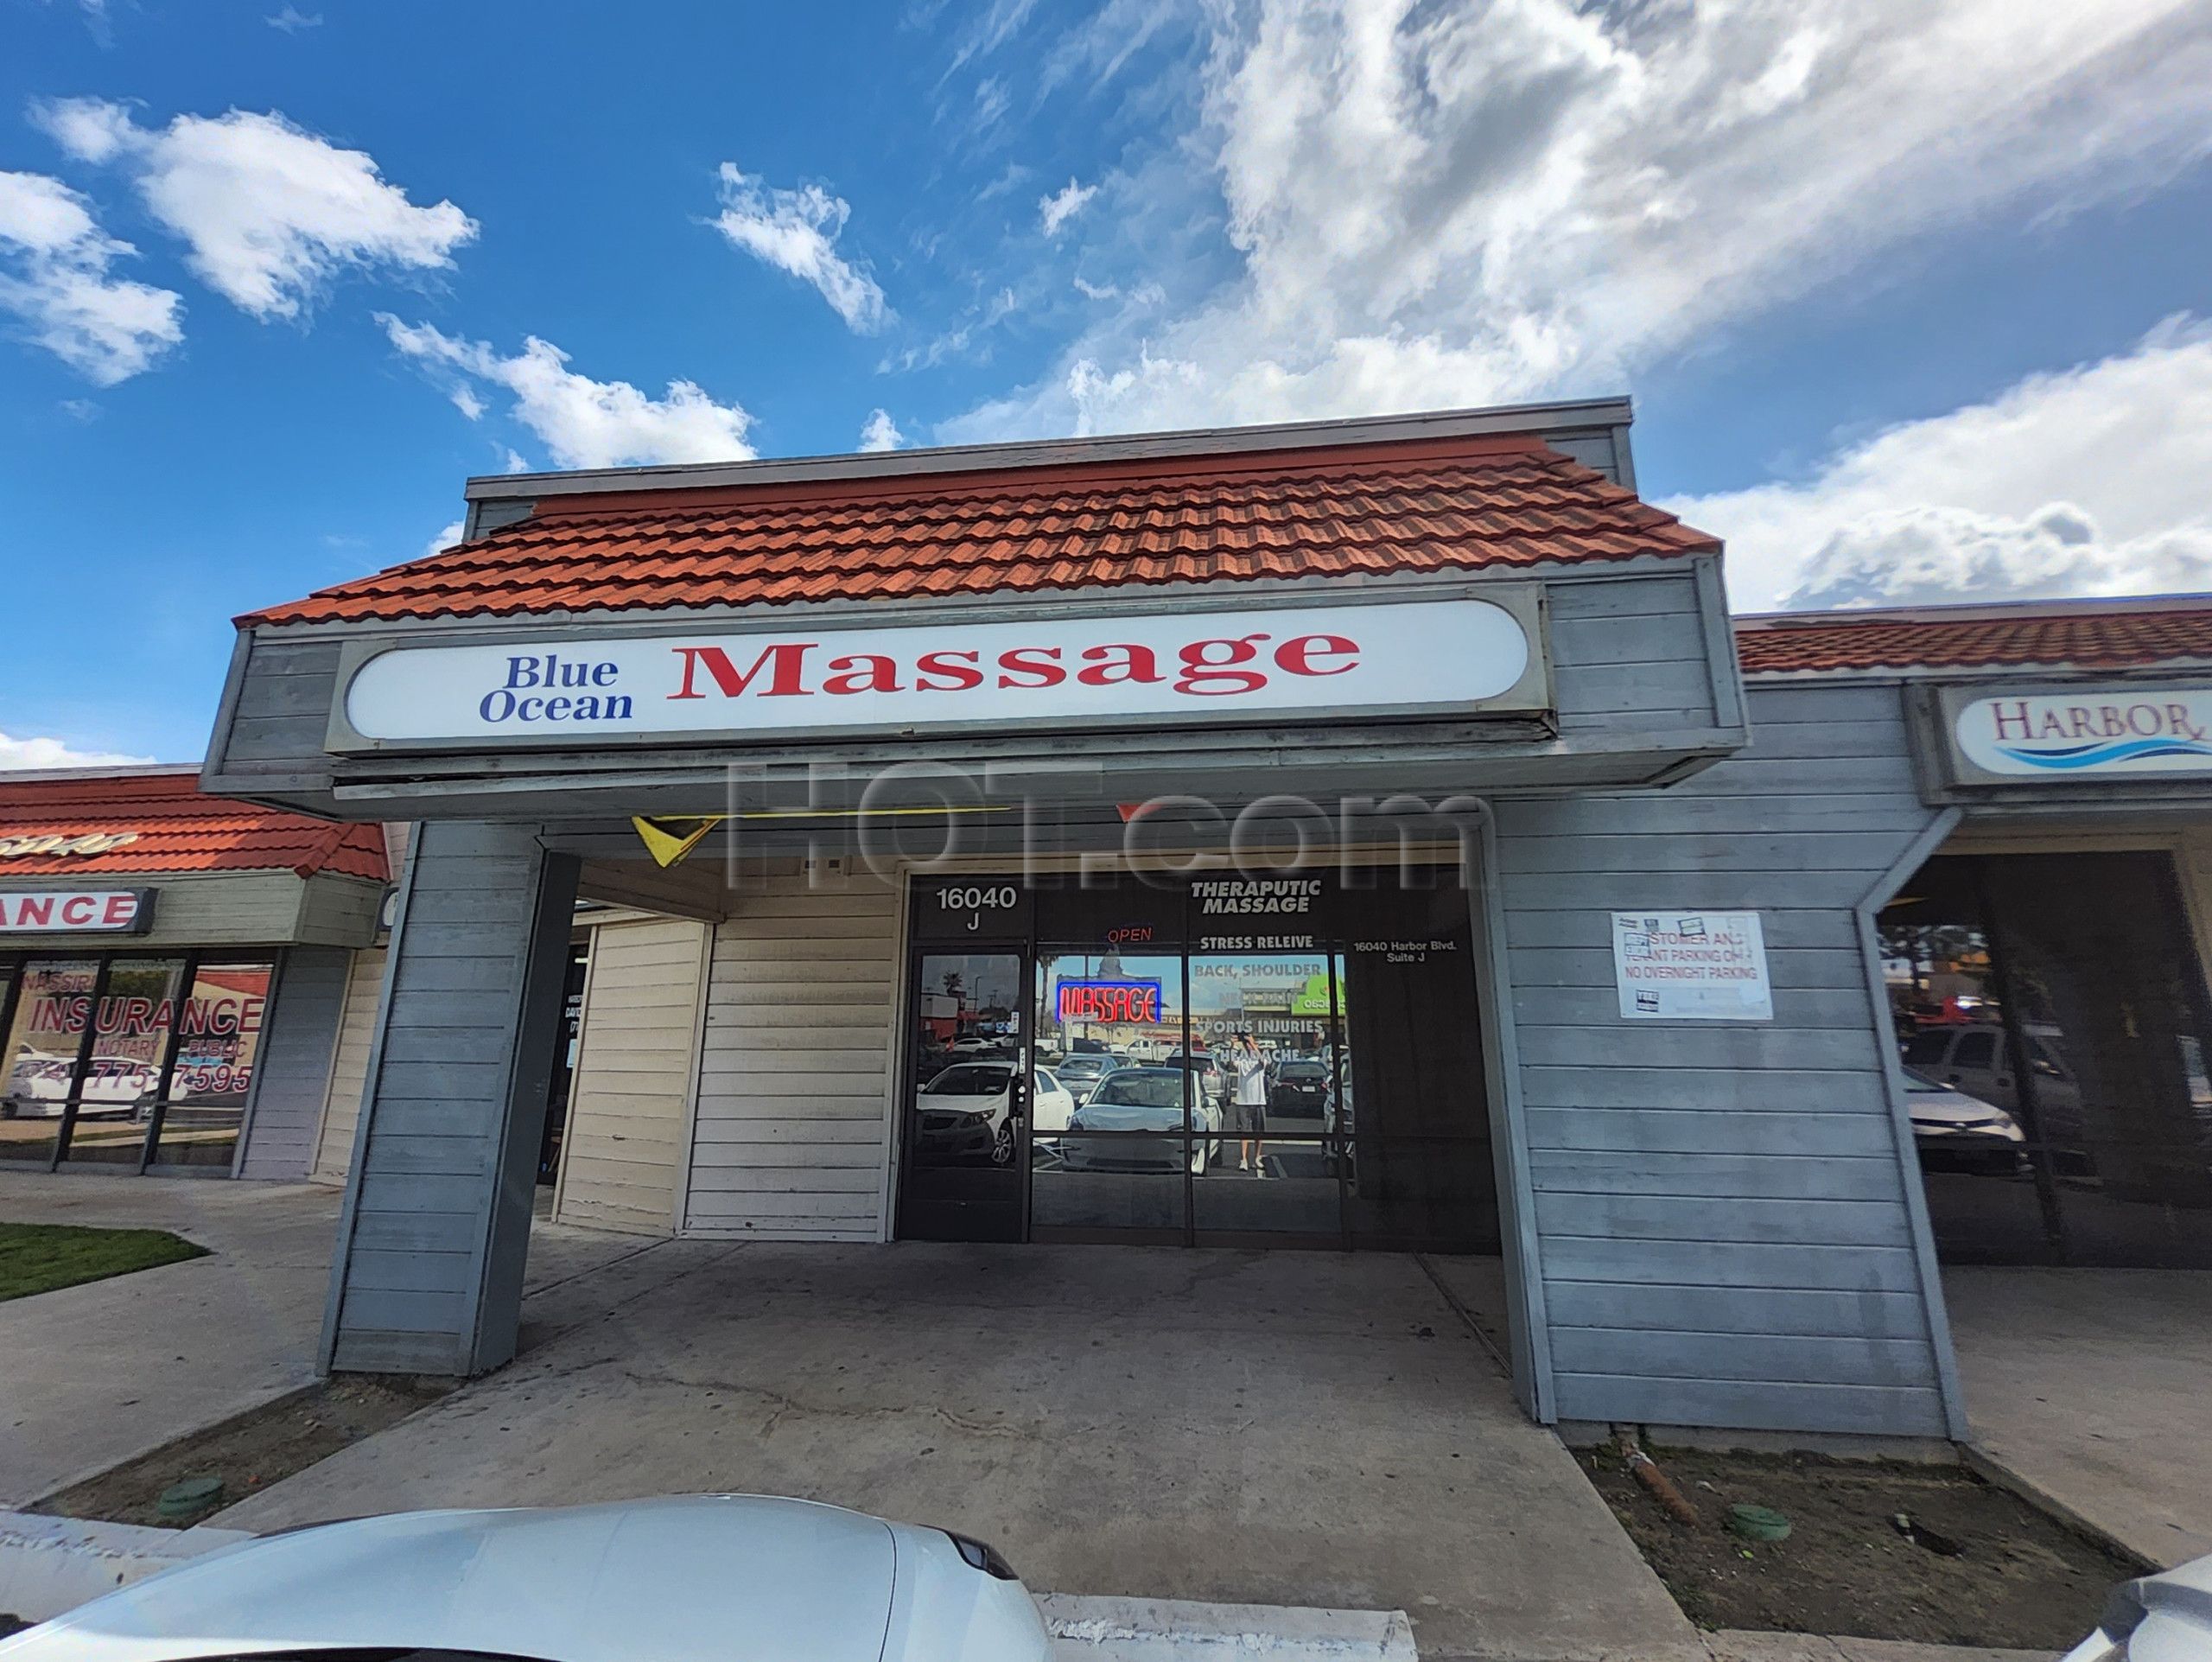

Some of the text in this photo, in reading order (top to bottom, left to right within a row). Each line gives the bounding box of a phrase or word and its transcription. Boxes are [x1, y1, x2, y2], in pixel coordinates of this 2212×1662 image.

[502, 654, 619, 689] Blue
[667, 634, 1361, 699] Massage
[479, 690, 632, 723] Ocean
[936, 887, 1017, 909] 16040
[1191, 880, 1321, 898] THERAPUTIC
[0, 895, 138, 927] NCE
[1202, 896, 1310, 914] MASSAGE
[967, 913, 980, 931] J
[1107, 927, 1153, 944] OPEN
[1200, 935, 1313, 950] STRESS RELEIVE
[1354, 940, 1457, 952] 16040 Harbor Blvd.
[1387, 952, 1426, 963] Suite J
[1672, 949, 1721, 962] PARKING
[1194, 964, 1321, 979] BACK, SHOULDER
[1625, 966, 1758, 979] NO OVERNIGHT PARKING
[1059, 986, 1158, 1022] MASSAGE
[29, 997, 264, 1035] INSURANCE
[1196, 1020, 1324, 1034] SPORTS INJURIES
[94, 1038, 248, 1057] NOTARY PUBLIC
[1219, 1048, 1300, 1063] HEADACHE
[174, 1063, 254, 1092] 7595
